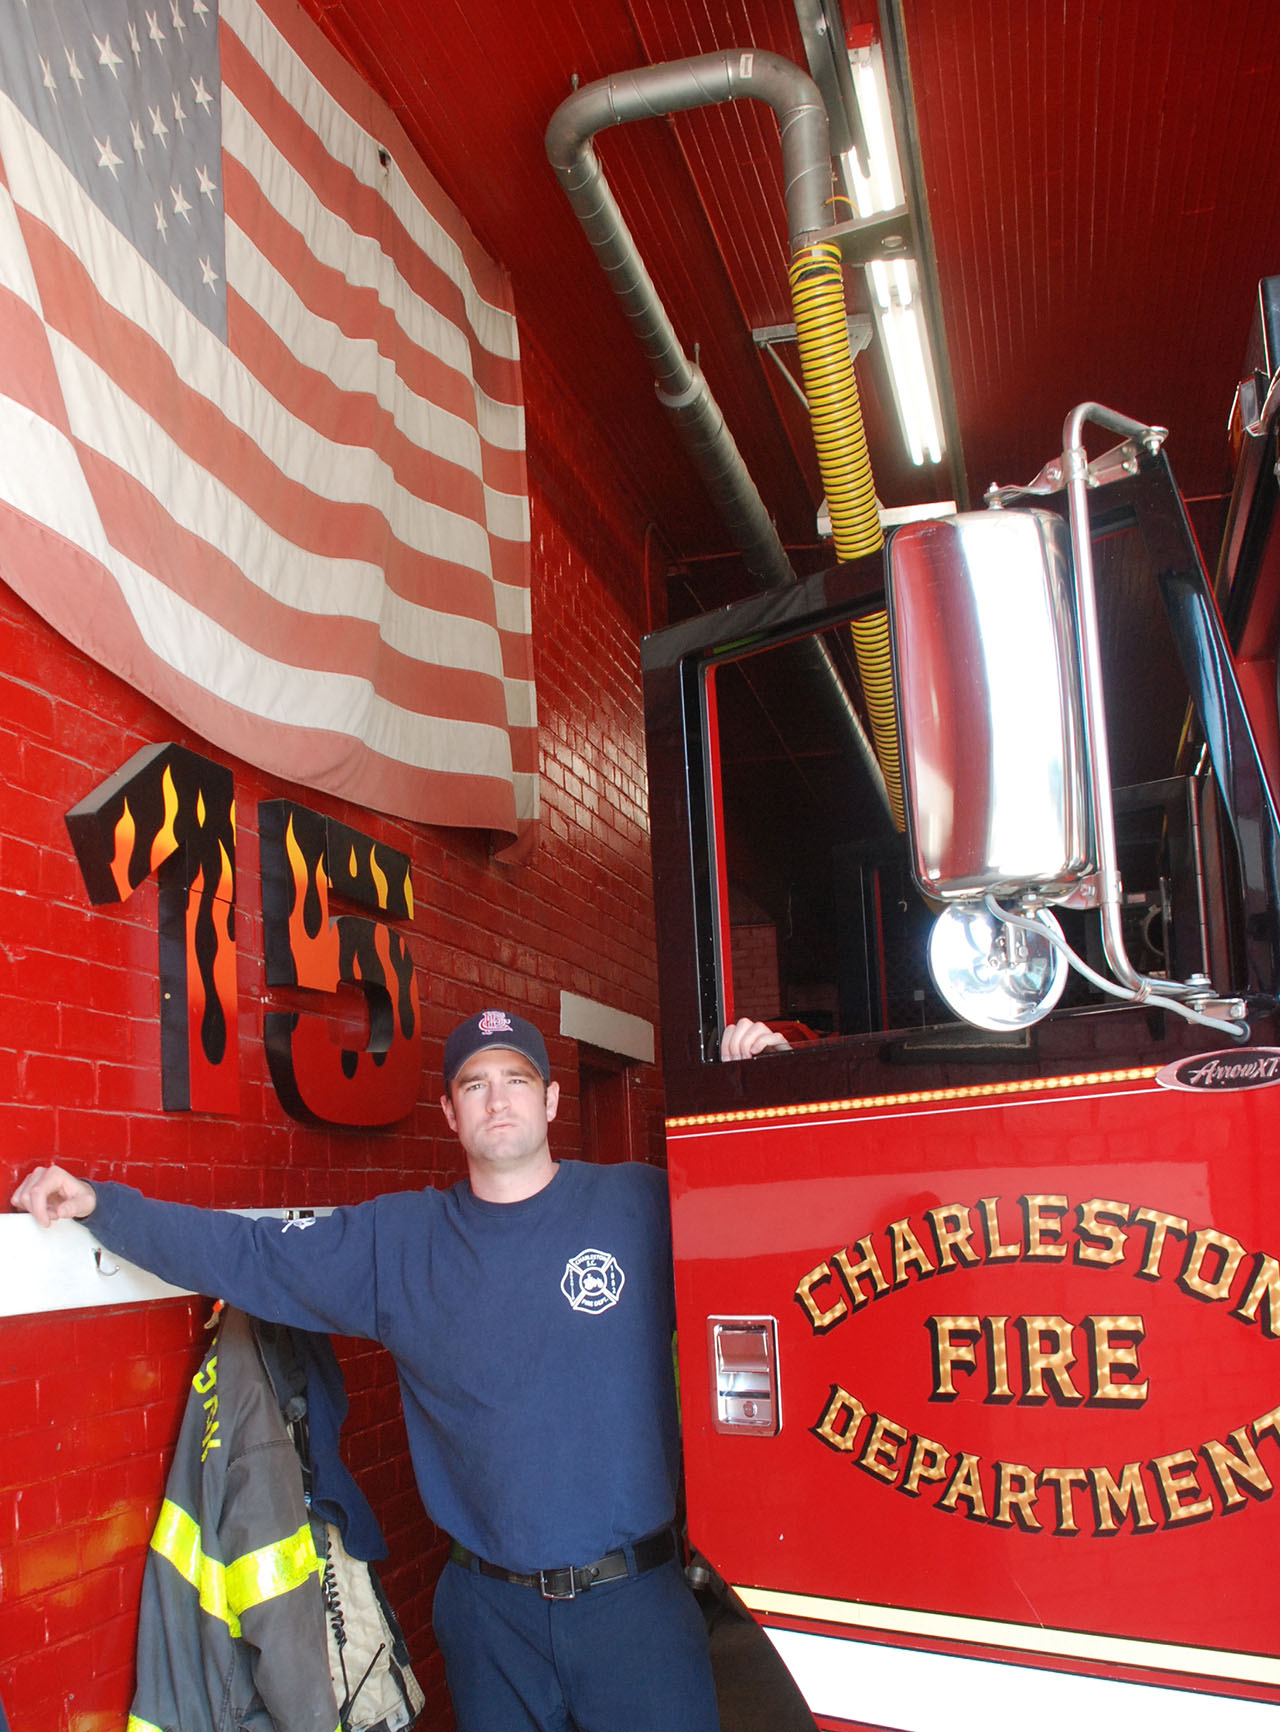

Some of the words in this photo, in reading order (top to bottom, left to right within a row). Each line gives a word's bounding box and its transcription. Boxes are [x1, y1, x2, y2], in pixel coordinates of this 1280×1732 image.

[65, 742, 423, 1127] 15
[795, 1194, 1280, 1339] CHARLESTON
[925, 1315, 1149, 1410] FIRE
